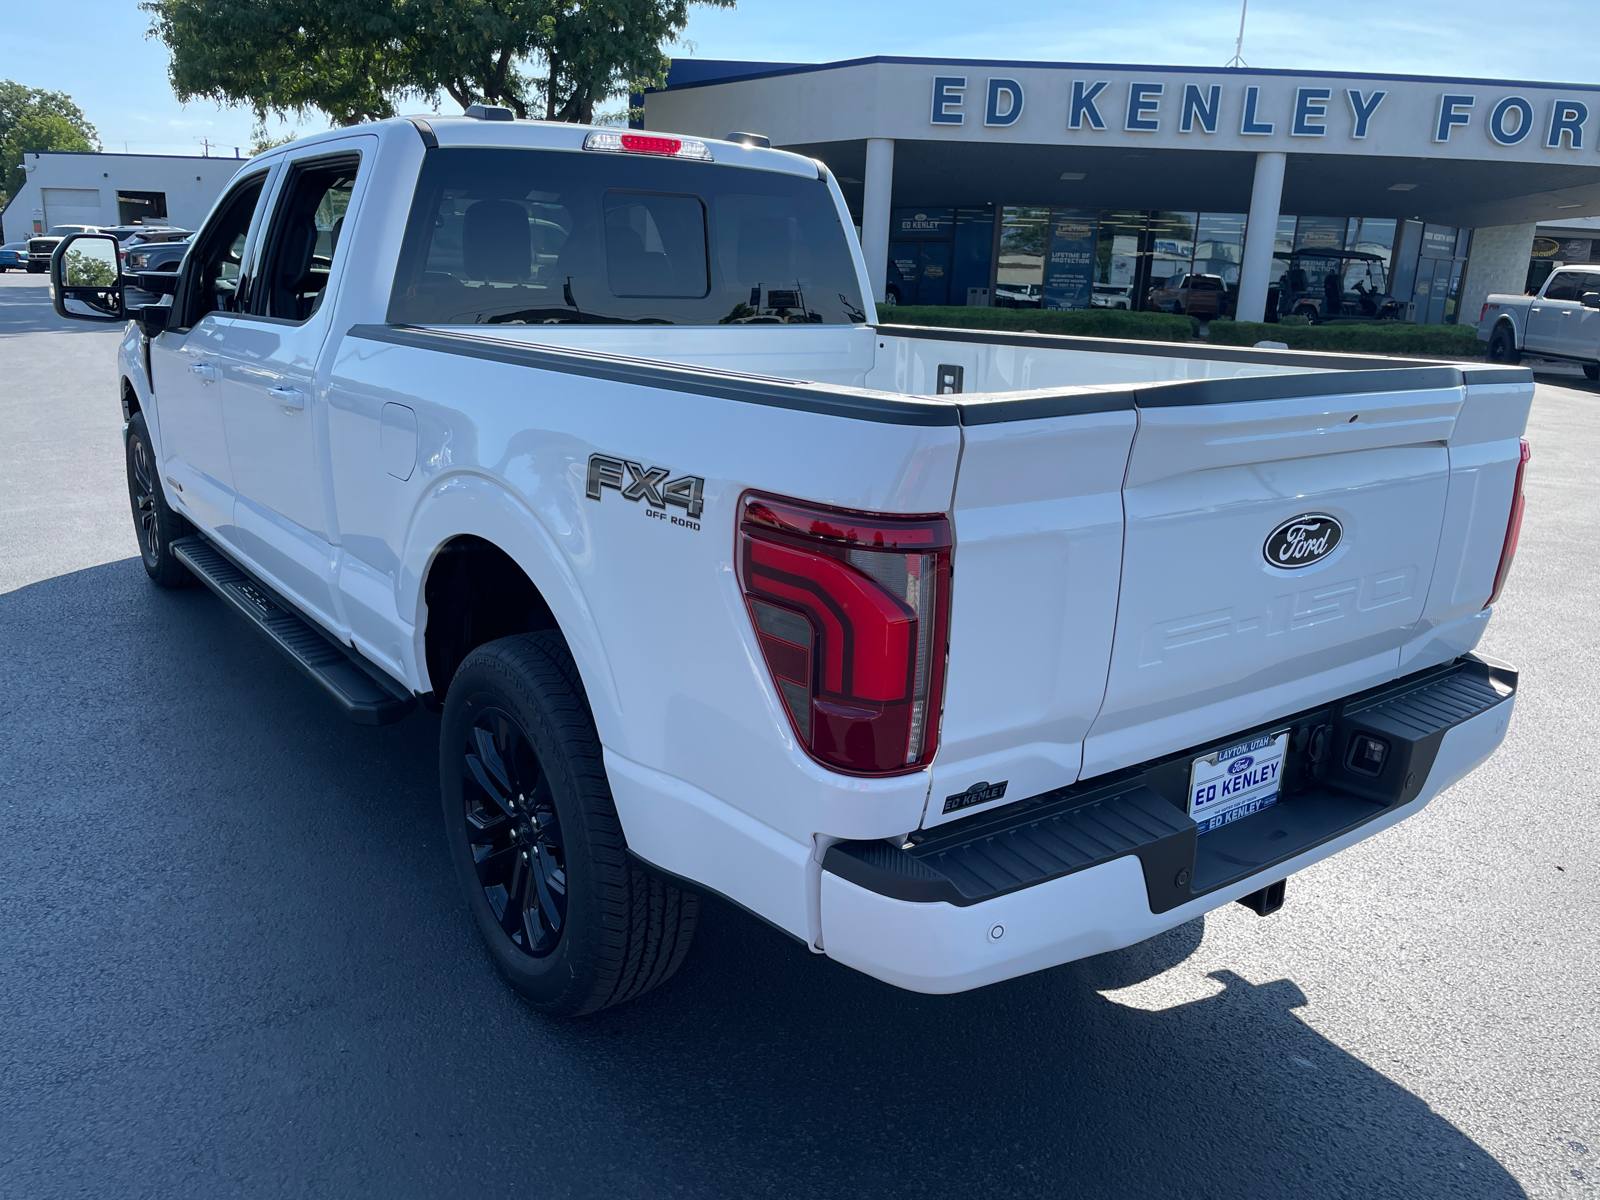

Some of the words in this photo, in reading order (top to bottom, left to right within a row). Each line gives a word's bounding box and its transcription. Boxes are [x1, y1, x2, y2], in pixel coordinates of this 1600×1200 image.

[929, 76, 1025, 127] ED
[1067, 80, 1388, 139] KENLEY
[1431, 93, 1600, 151] FOR
[901, 221, 911, 229] ED
[912, 221, 939, 229] KENLEY
[585, 452, 705, 521] FX4
[645, 508, 667, 520] OFF
[670, 515, 701, 531] ROAD
[1279, 522, 1331, 561] Ford
[1218, 743, 1249, 761] LAYTON,
[1250, 736, 1269, 751] UTAH
[944, 798, 960, 811] ED
[962, 785, 1006, 806] KENLEY
[1195, 784, 1217, 806] ED
[1221, 761, 1279, 797] KENLEY
[1208, 813, 1223, 829] ED
[1225, 799, 1262, 824] KENLEY
